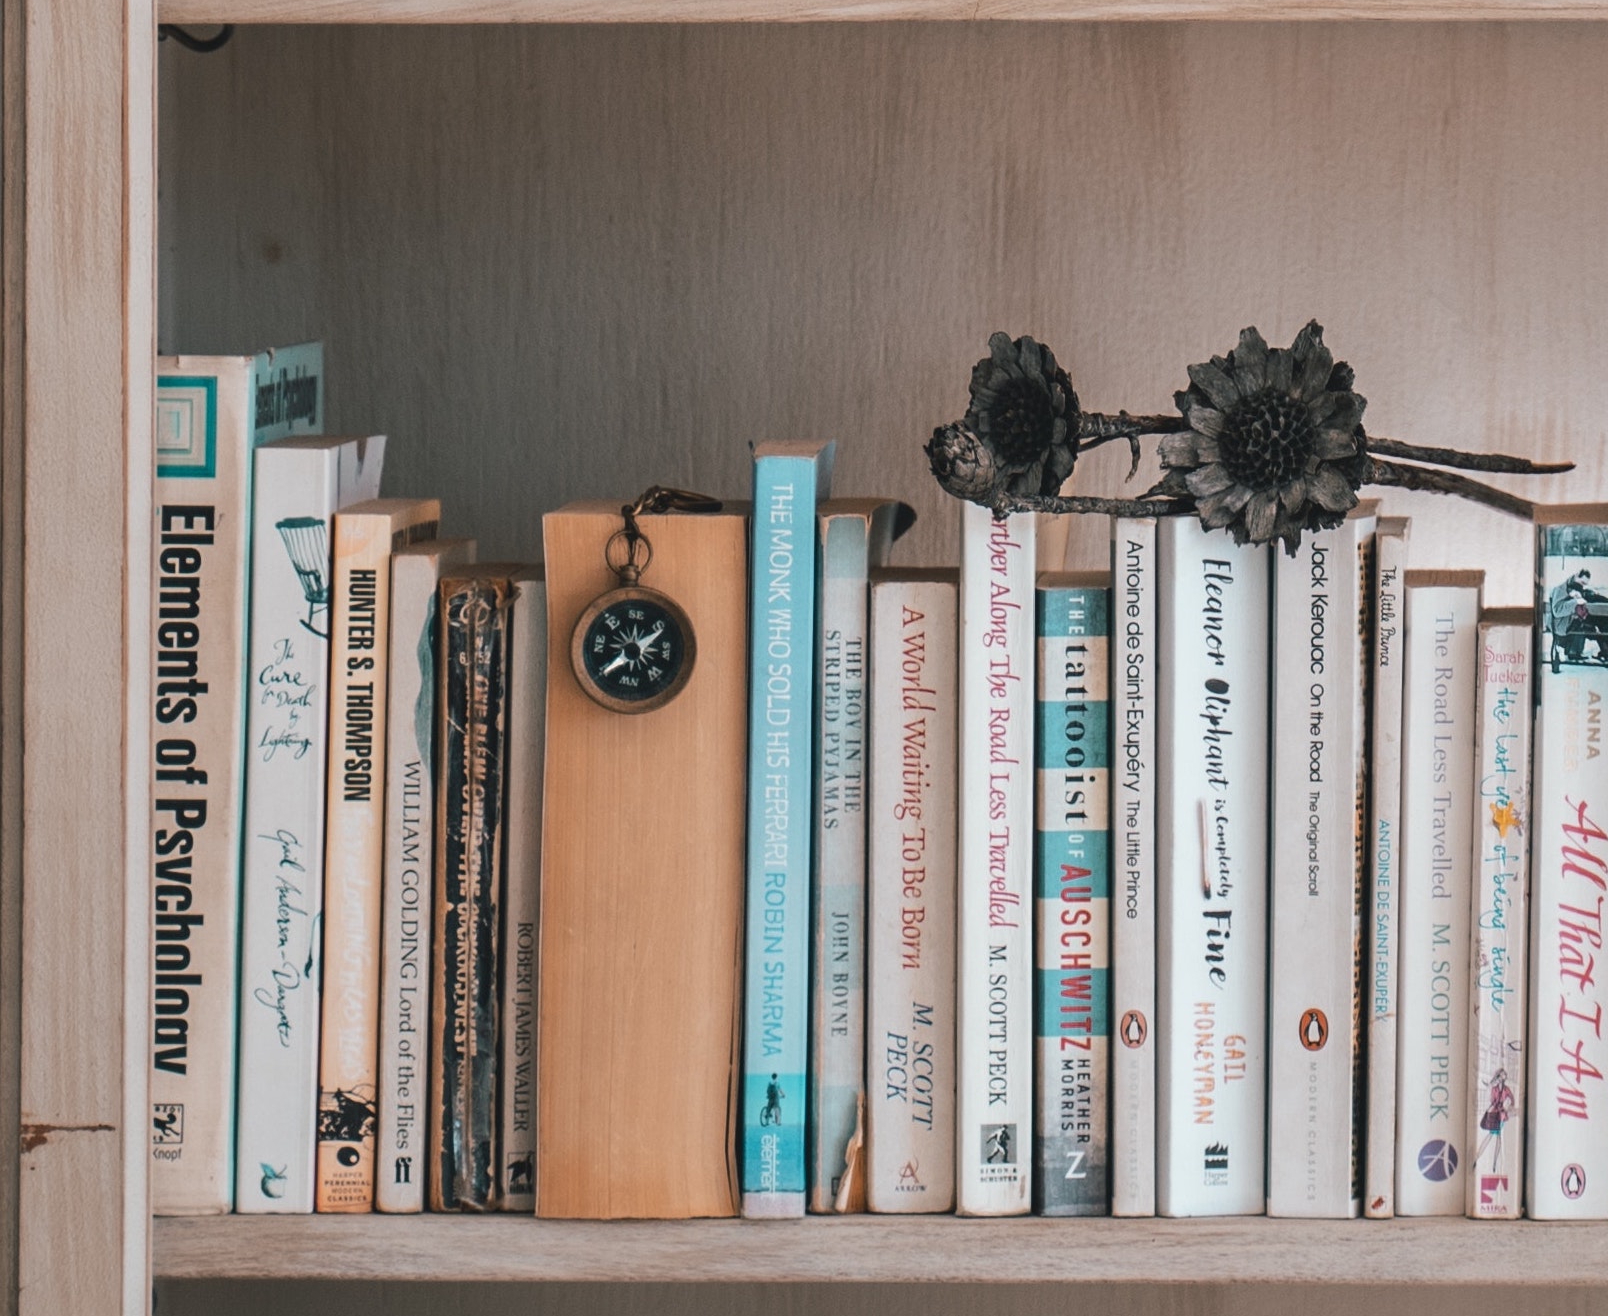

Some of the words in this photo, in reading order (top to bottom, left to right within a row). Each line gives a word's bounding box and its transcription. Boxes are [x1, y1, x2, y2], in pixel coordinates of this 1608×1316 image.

[1126, 540, 1145, 618] Antoine
[1310, 542, 1330, 585] Jack
[348, 569, 375, 653] HUNTER
[1068, 595, 1086, 634] THE
[1310, 593, 1330, 673] Kerouac
[1126, 625, 1145, 650] de
[345, 658, 372, 676] S.
[1310, 683, 1324, 707] On
[343, 684, 371, 802] THOMPSON
[1064, 643, 1094, 822] tattooist
[1123, 655, 1146, 791] Saint-Exupéry
[1310, 711, 1325, 736] the
[1310, 742, 1325, 782] Road
[399, 760, 421, 862] WILLIAM
[1126, 799, 1141, 826] The
[1309, 791, 1320, 812] The
[1068, 833, 1086, 858] OF
[1126, 831, 1141, 865] Little
[1306, 815, 1320, 859] Original
[1126, 868, 1141, 918] Prince
[1309, 863, 1320, 895] Scroll
[398, 867, 419, 980] GOLDING
[514, 923, 533, 997] ROBERT
[1061, 864, 1092, 1051] AUSCHWITZ
[397, 984, 417, 1035] Lord
[513, 1002, 531, 1057] JAMES
[396, 1040, 415, 1059] of
[396, 1065, 415, 1097] the
[512, 1062, 530, 1132] WALLER
[1061, 1058, 1075, 1134] MORRIS
[1078, 1058, 1091, 1143] HEATHER
[394, 1102, 414, 1150] Flies
